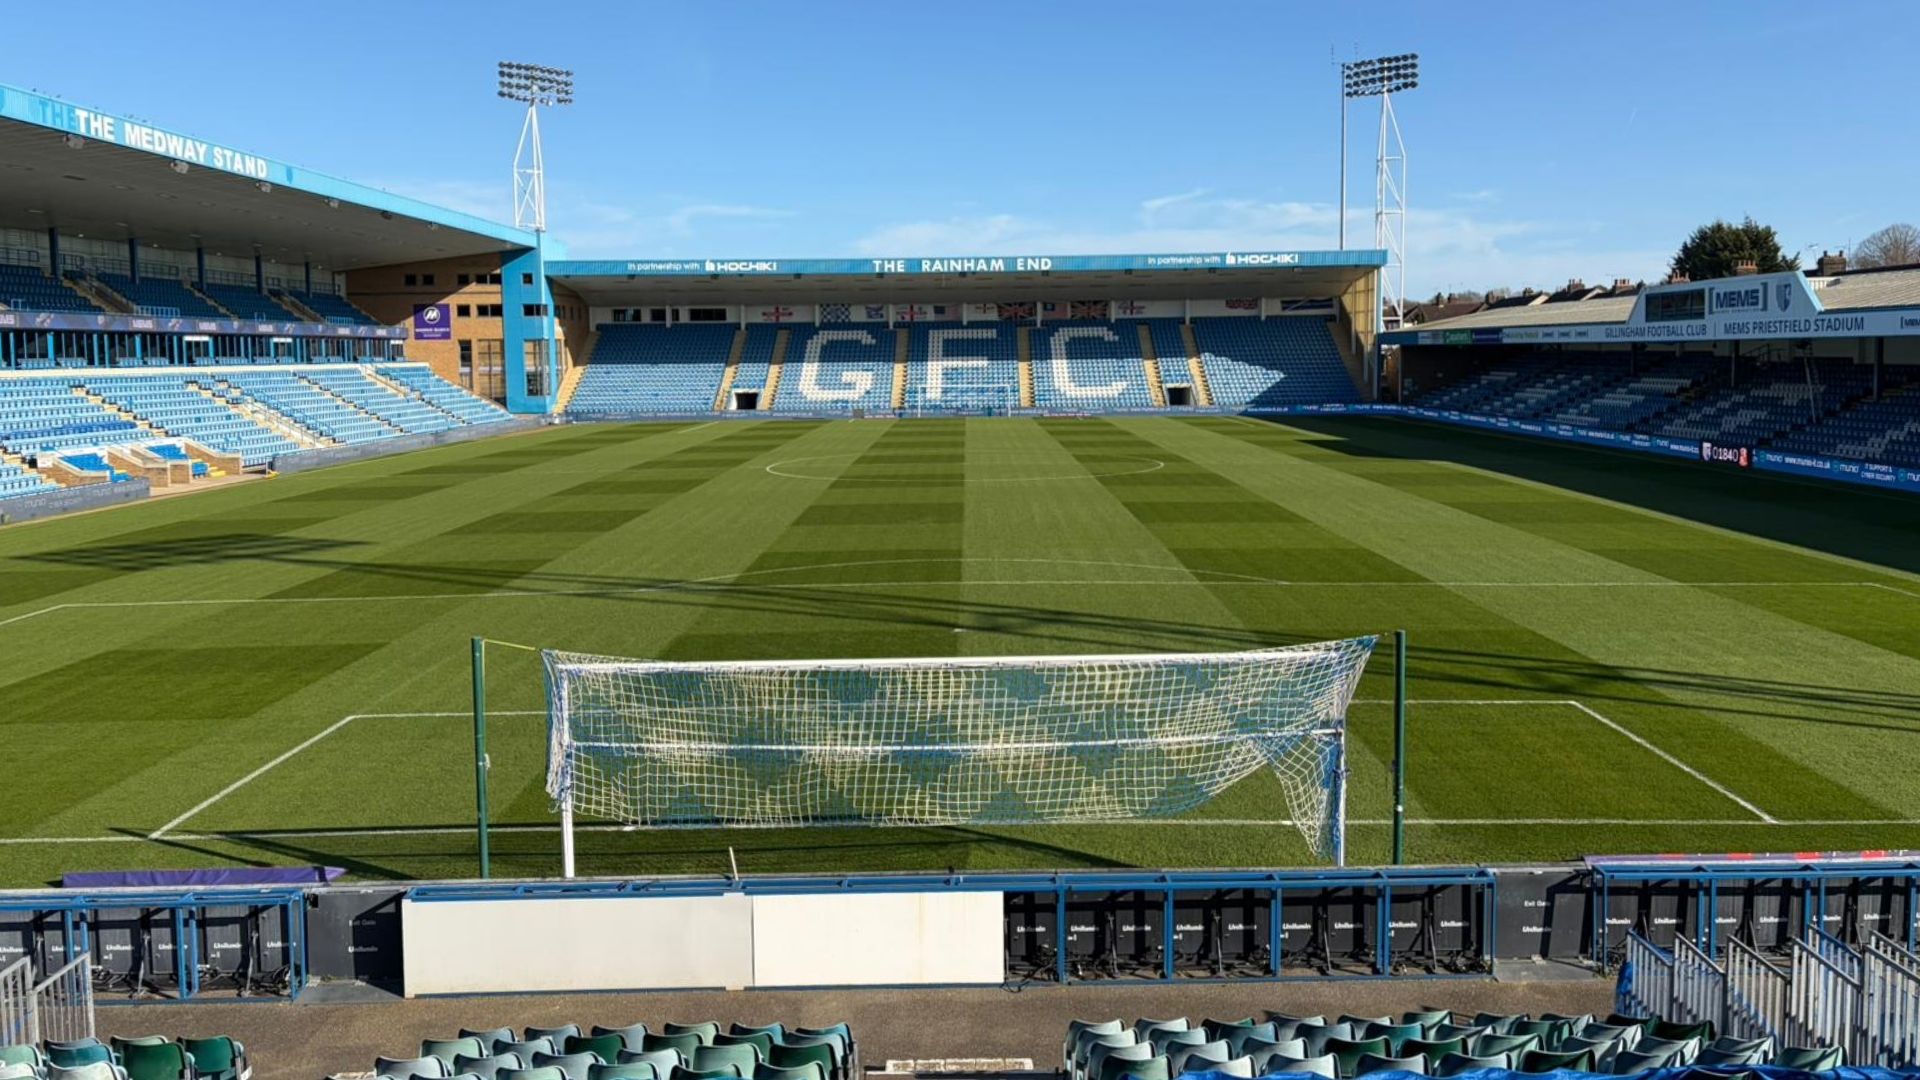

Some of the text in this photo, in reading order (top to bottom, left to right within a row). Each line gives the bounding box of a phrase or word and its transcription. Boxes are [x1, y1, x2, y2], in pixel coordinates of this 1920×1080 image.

[75, 109, 269, 179] THE MEDWAY STAND
[627, 262, 777, 274] In partnership with HOCHIKI
[872, 257, 1053, 273] THE RAINHAM END
[1148, 253, 1299, 267] In partnership with HOCHIKI
[1715, 288, 1760, 309] MEMS
[1604, 323, 1708, 339] GILLINGHAM FOOTBALL CLUB
[1723, 316, 1865, 335] MEMS PRIESTFIELD STADIUM
